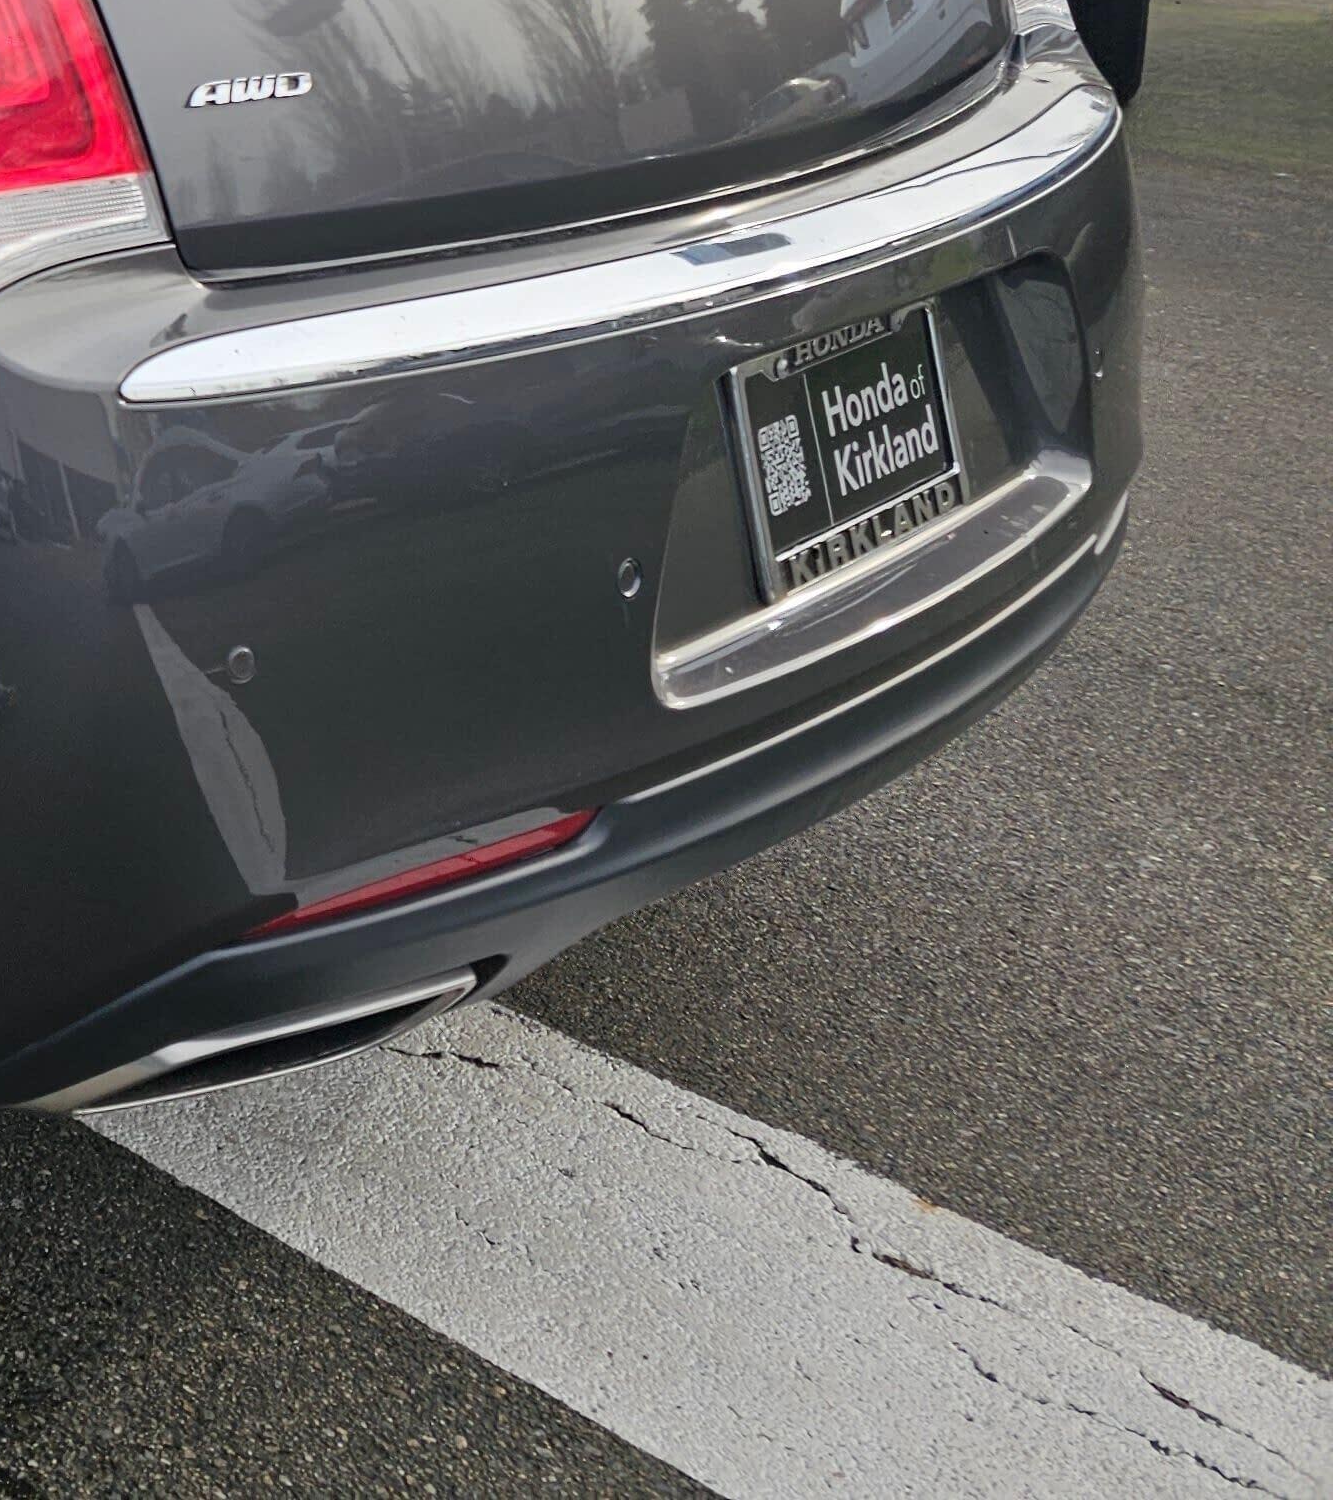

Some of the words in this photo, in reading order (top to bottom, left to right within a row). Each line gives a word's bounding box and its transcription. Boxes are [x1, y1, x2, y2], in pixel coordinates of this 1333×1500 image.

[187, 71, 313, 108] AWD
[793, 316, 885, 367] HONDA
[821, 362, 909, 437] Honda
[909, 363, 926, 399] of
[833, 403, 939, 496] Kirkland
[788, 481, 956, 592] KIRKLAND
